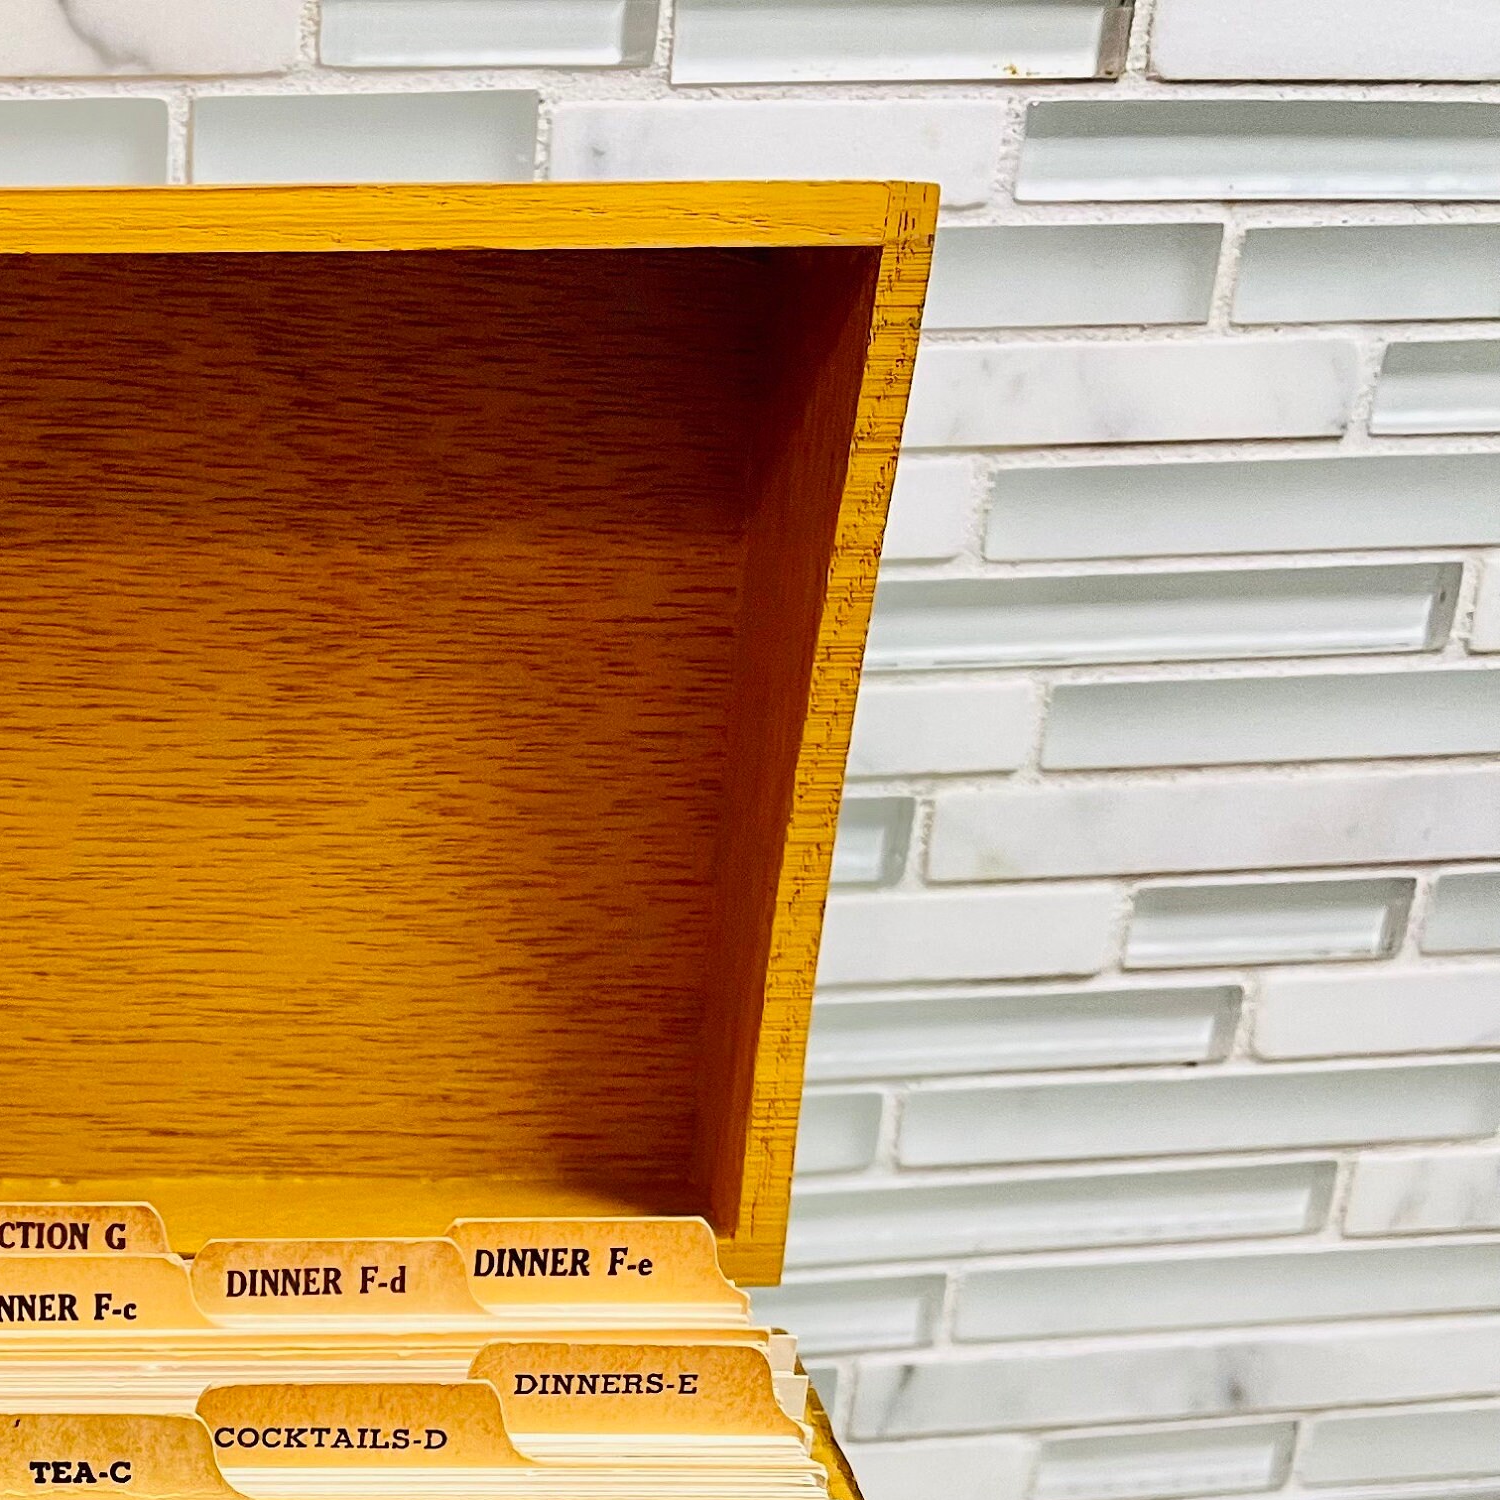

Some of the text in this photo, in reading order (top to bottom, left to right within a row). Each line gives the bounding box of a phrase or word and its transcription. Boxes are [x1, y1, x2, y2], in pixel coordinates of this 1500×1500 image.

[104, 1222, 126, 1251] G
[473, 1246, 653, 1278] DINNER F-e
[226, 1265, 407, 1298] DINNER F-d
[93, 1293, 137, 1321] F-c
[513, 1372, 699, 1395] DINNERS-E
[214, 1427, 448, 1450] COCKTAILS-D
[29, 1461, 132, 1484] TEA-C
